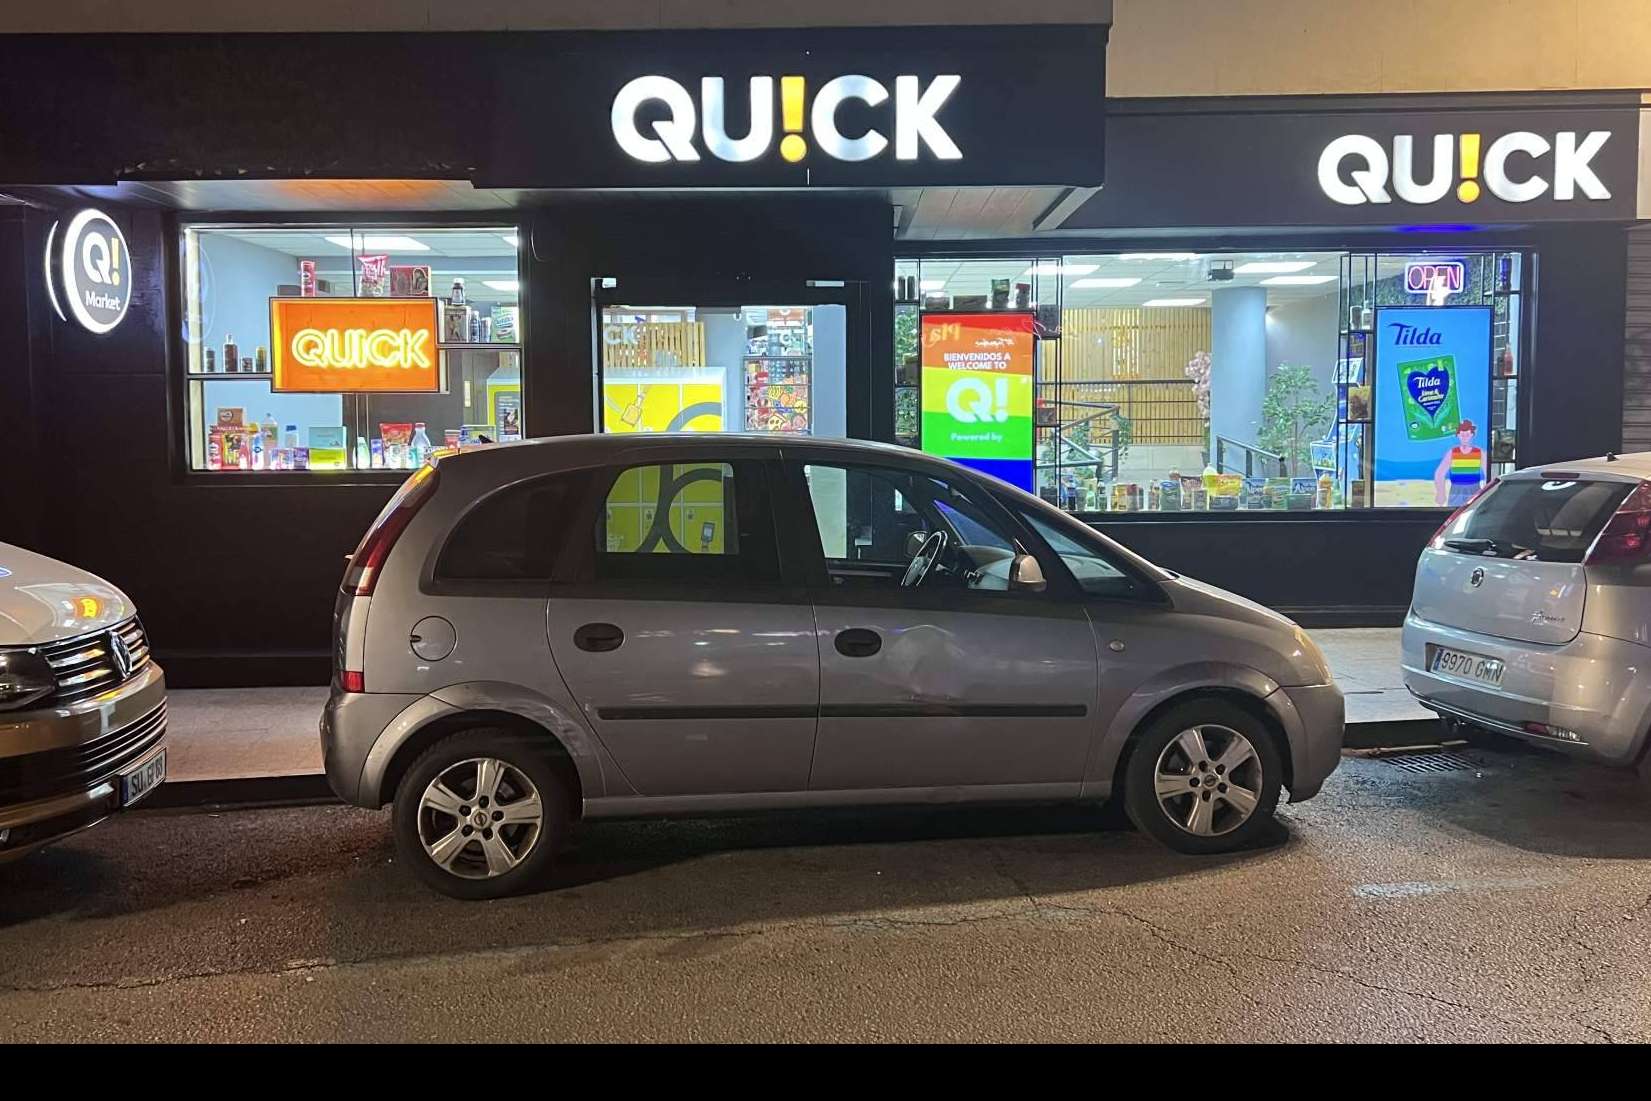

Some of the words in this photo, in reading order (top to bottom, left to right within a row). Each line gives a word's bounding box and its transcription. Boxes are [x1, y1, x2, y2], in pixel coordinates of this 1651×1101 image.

[610, 74, 964, 163] QU!CK
[1317, 131, 1613, 206] QU!CK
[82, 231, 121, 286] Q!
[1408, 265, 1460, 290] OPEN
[84, 290, 121, 312] Market
[1388, 322, 1442, 346] Tilda
[291, 327, 432, 370] QUICK
[944, 353, 1002, 361] BIENVENIDOS
[1003, 353, 1011, 361] A
[948, 362, 993, 370] WELCOME
[995, 362, 1007, 370] TO
[1413, 376, 1440, 388] Tilda
[946, 378, 1008, 422] Q!
[950, 432, 990, 442] Powered
[991, 432, 1003, 443] by
[1441, 652, 1473, 675] 9970
